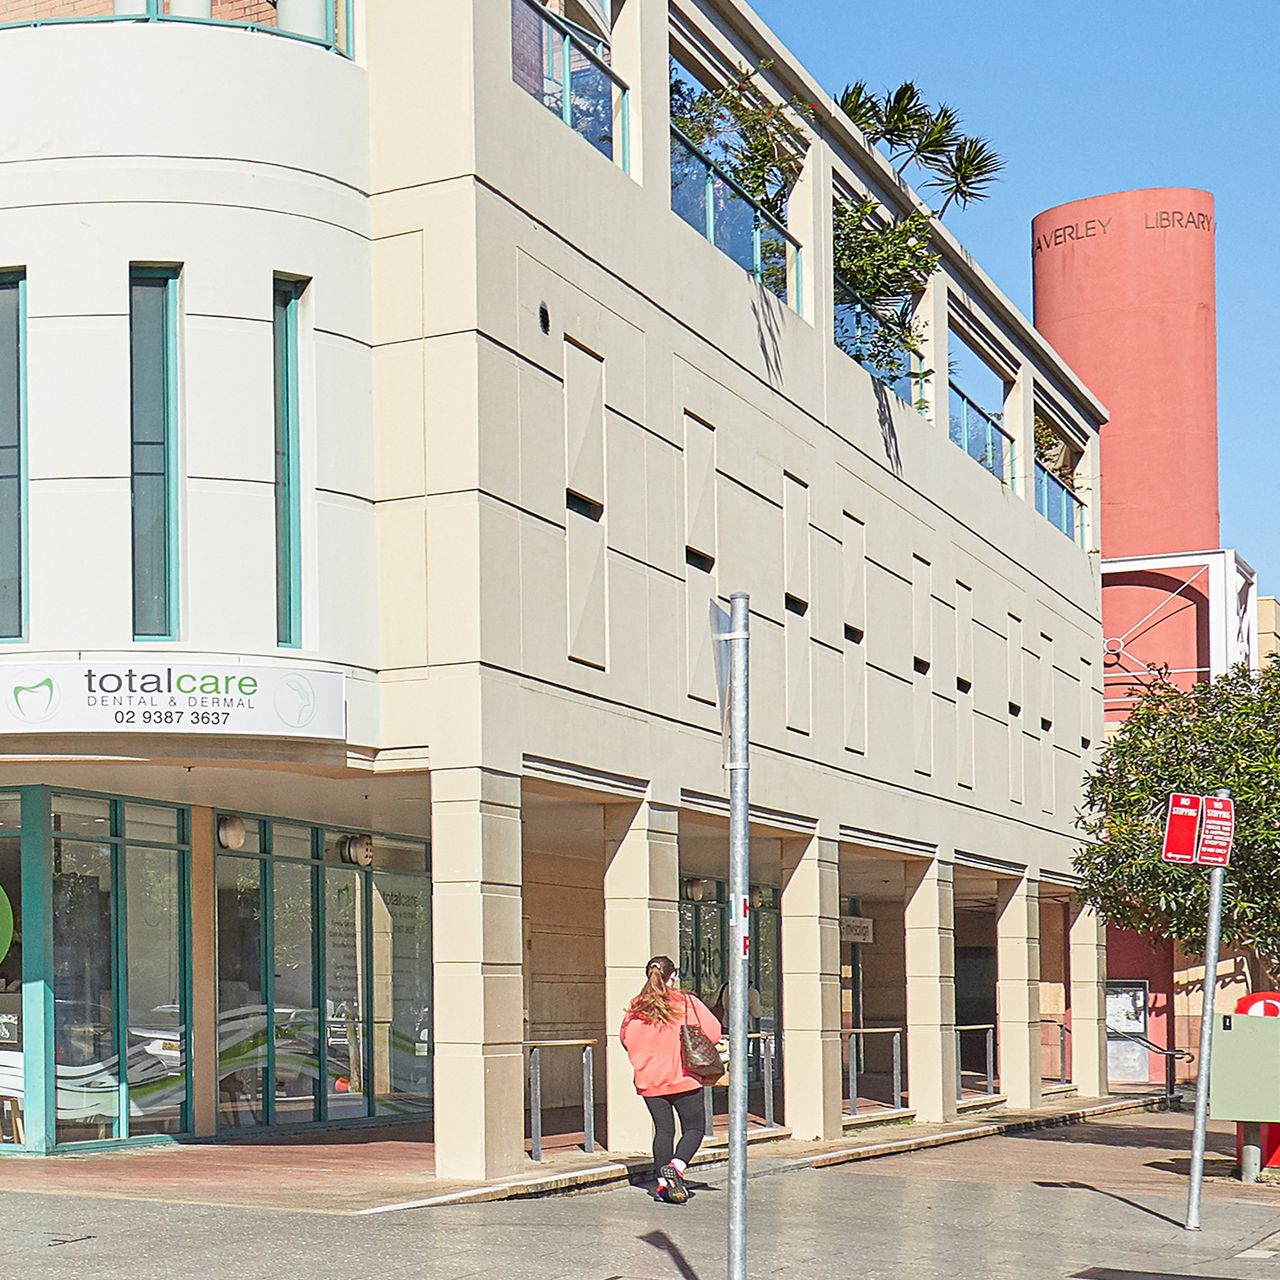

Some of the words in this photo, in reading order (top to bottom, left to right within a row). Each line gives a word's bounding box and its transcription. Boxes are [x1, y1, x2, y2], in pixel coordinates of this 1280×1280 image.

[1036, 217, 1112, 252] AVERLEY
[1145, 211, 1212, 232] LIBRARY
[84, 668, 258, 695] totalcare
[87, 696, 158, 707] DENTAL
[168, 696, 177, 706] &
[188, 697, 255, 709] DERMAL
[114, 710, 135, 724] 02
[142, 710, 184, 724] 9387
[190, 711, 230, 725] 3637
